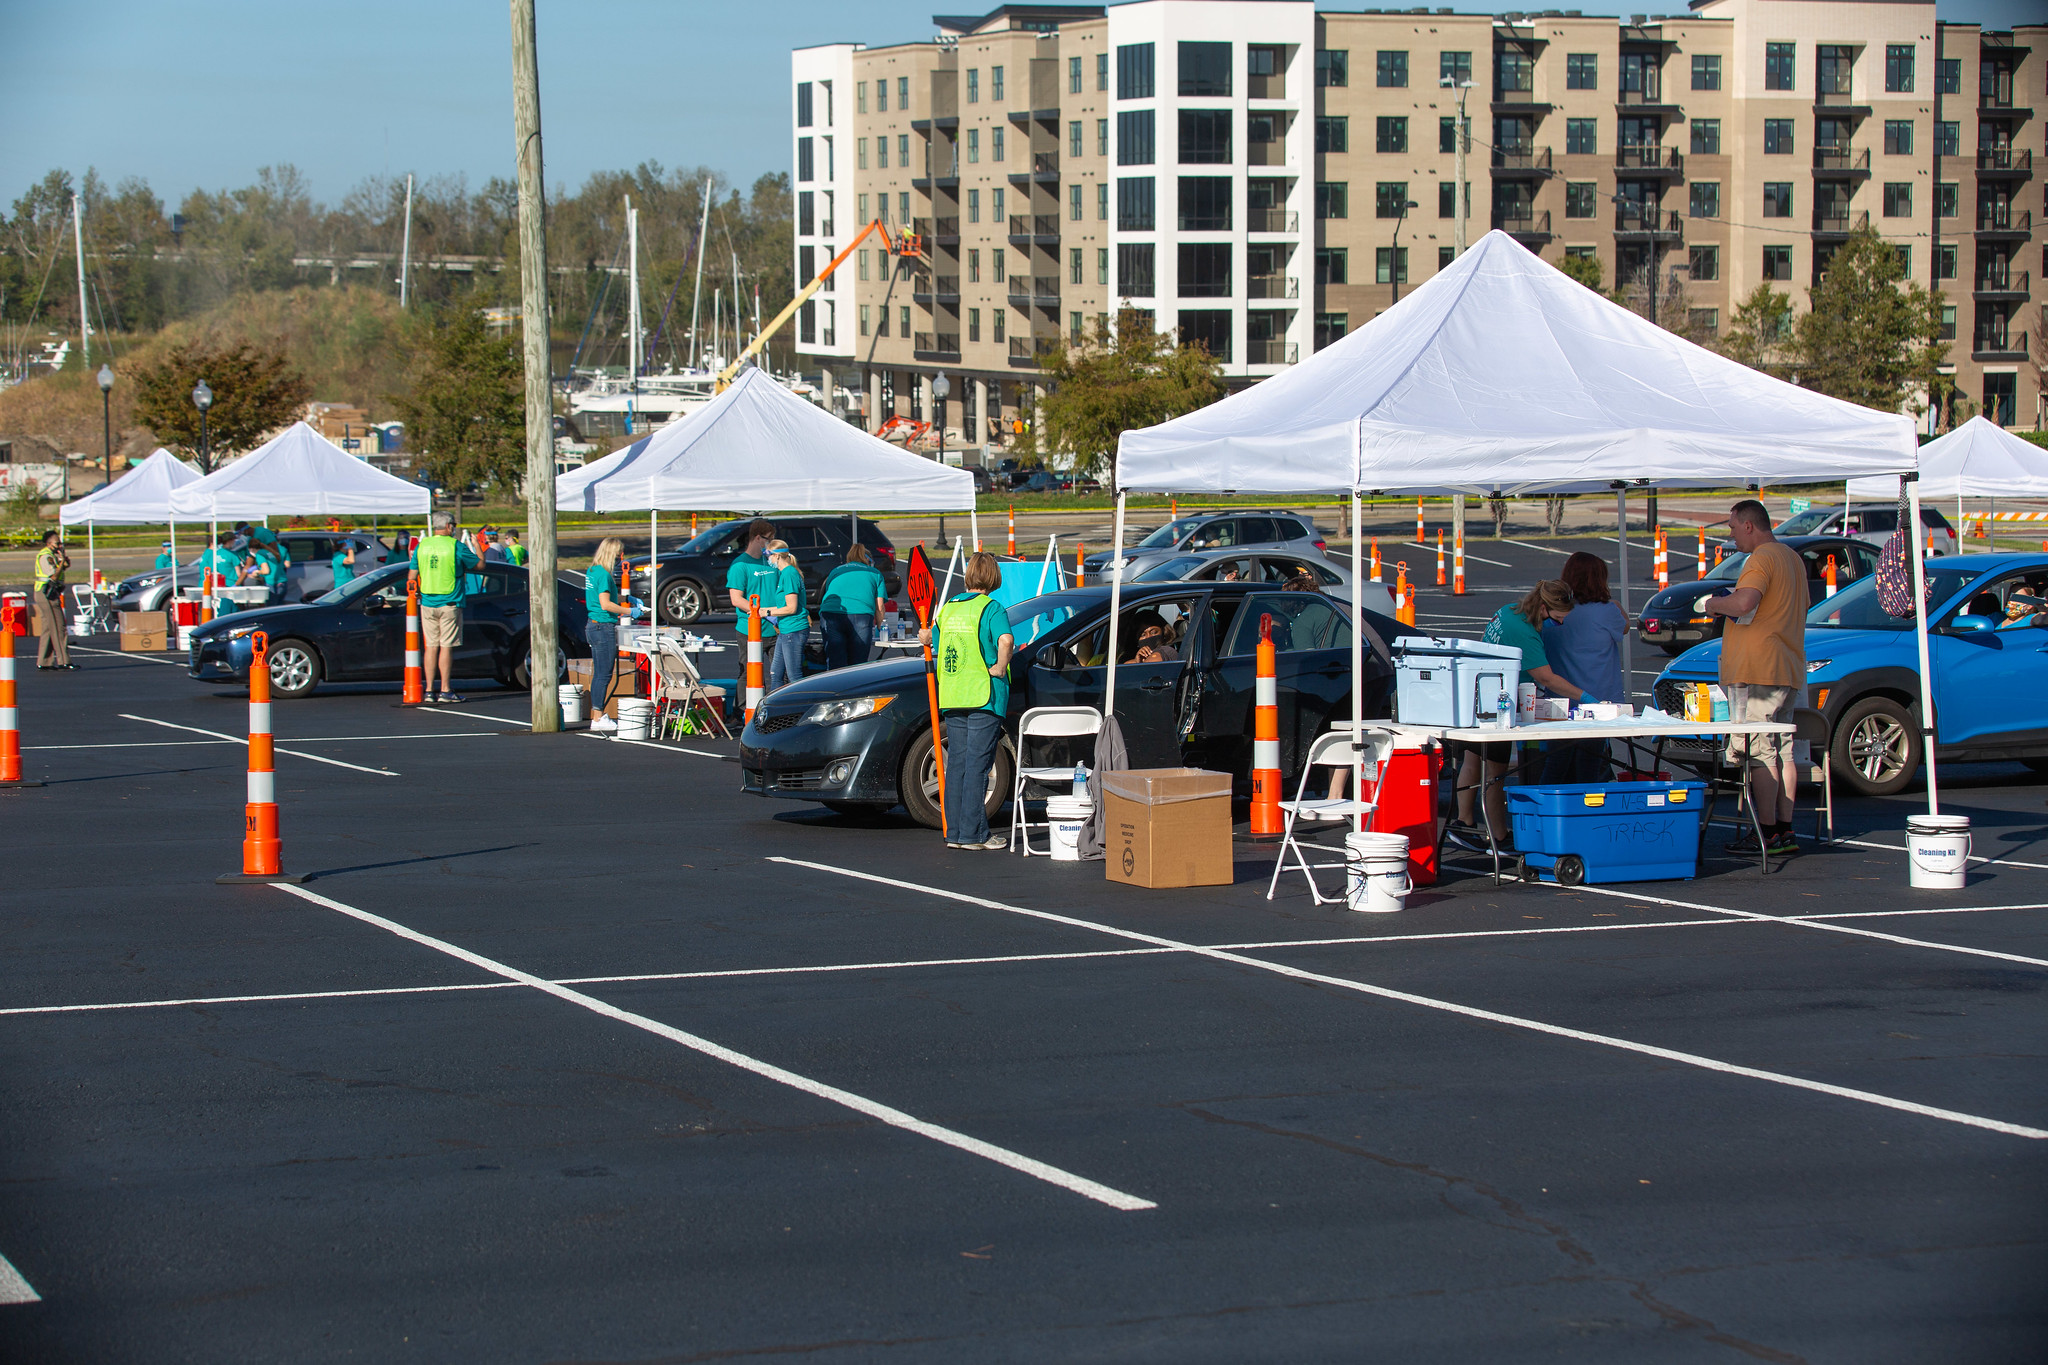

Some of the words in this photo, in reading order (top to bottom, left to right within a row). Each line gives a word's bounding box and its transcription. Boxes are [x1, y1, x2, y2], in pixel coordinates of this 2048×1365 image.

[909, 571, 931, 603] SLOW
[1592, 820, 1675, 848] TRASK
[1918, 848, 1947, 857] Cleaning
